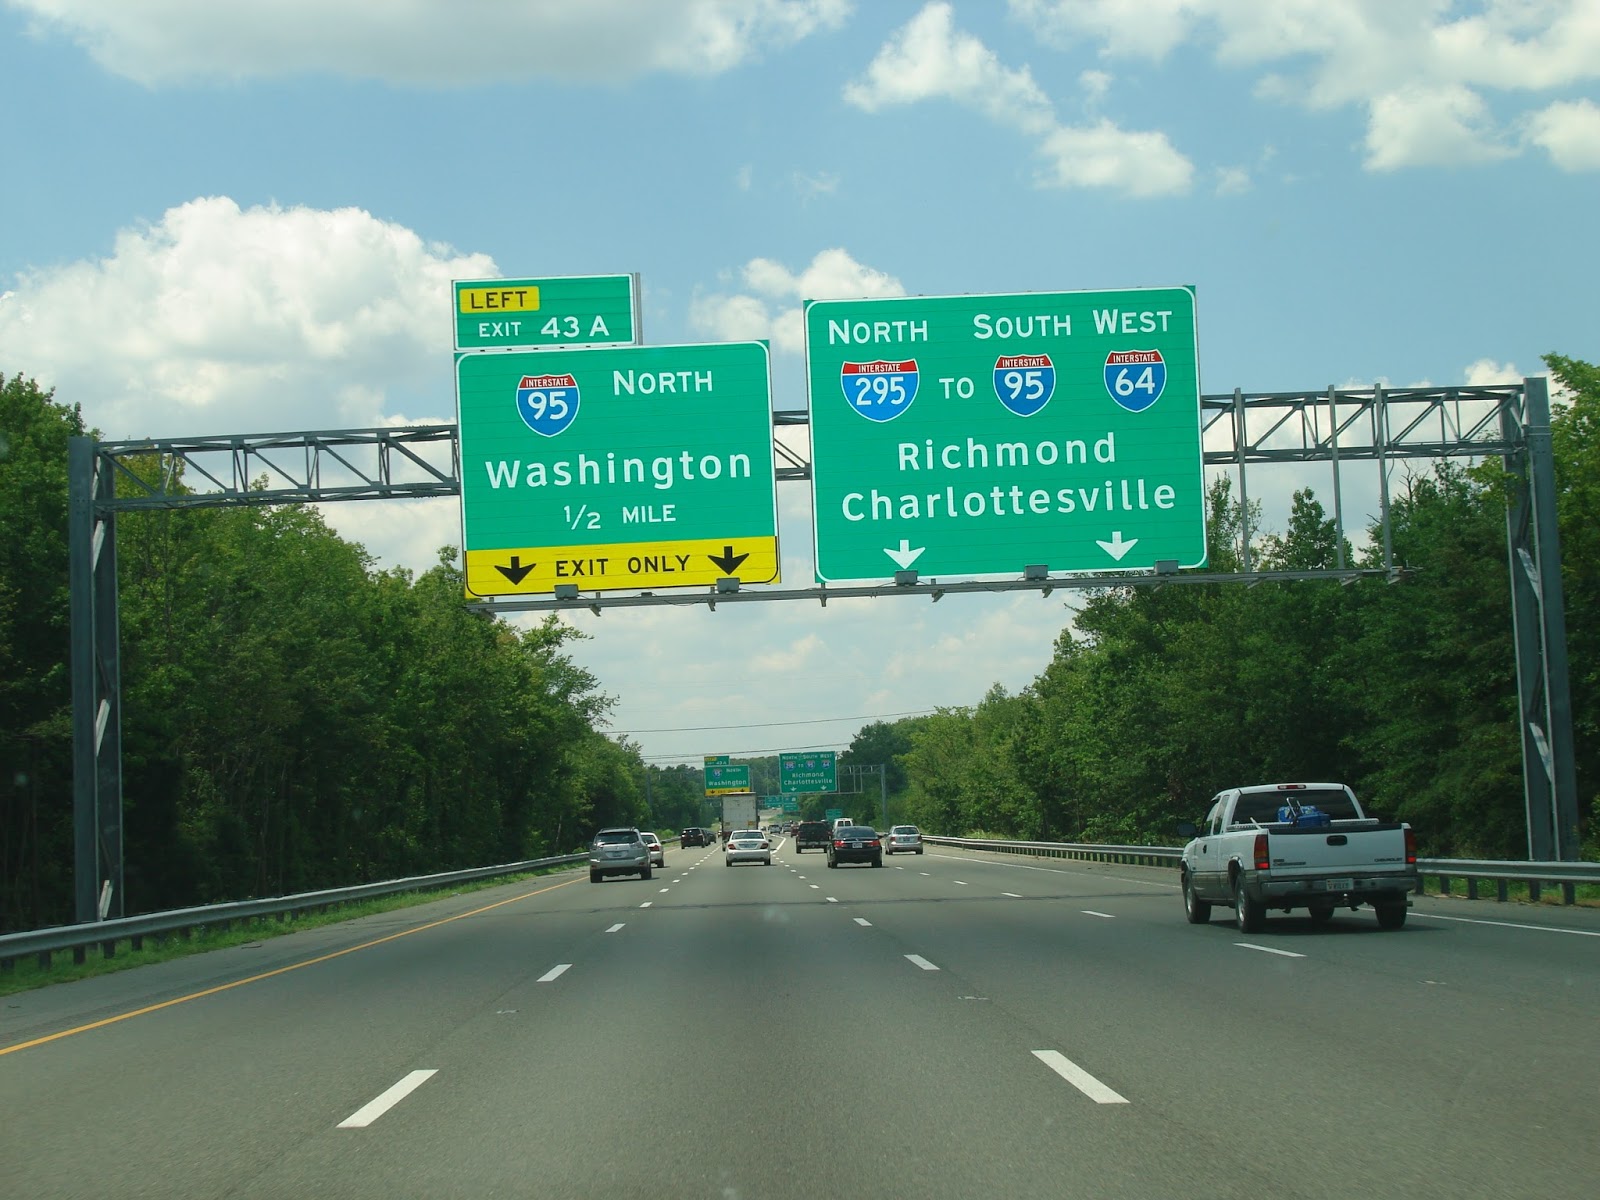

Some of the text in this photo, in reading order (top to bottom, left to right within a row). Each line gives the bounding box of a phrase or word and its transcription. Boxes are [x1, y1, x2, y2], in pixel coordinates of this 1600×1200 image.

[470, 290, 527, 309] LEFT
[478, 315, 610, 338] EXIT 43 A
[828, 319, 928, 345] NORTH
[973, 313, 1071, 340] SOUTH
[1092, 308, 1172, 334] WEST
[858, 363, 901, 373] INTERSTATE
[1002, 356, 1045, 367] INTERSTATE
[1113, 352, 1156, 363] INTERSTATE
[525, 376, 569, 388] INTERSTATE
[613, 369, 713, 396] NORTH
[855, 376, 906, 406] 295
[938, 376, 975, 400] TO
[1003, 370, 1044, 400] 95
[1114, 366, 1156, 397] 64
[527, 391, 569, 420] 95
[897, 432, 1116, 471] Richmond
[485, 451, 751, 490] Washington
[841, 479, 1176, 522] Charlottesville
[563, 504, 676, 530] 1/2 MILE
[555, 554, 690, 577] EXIT ONLY
